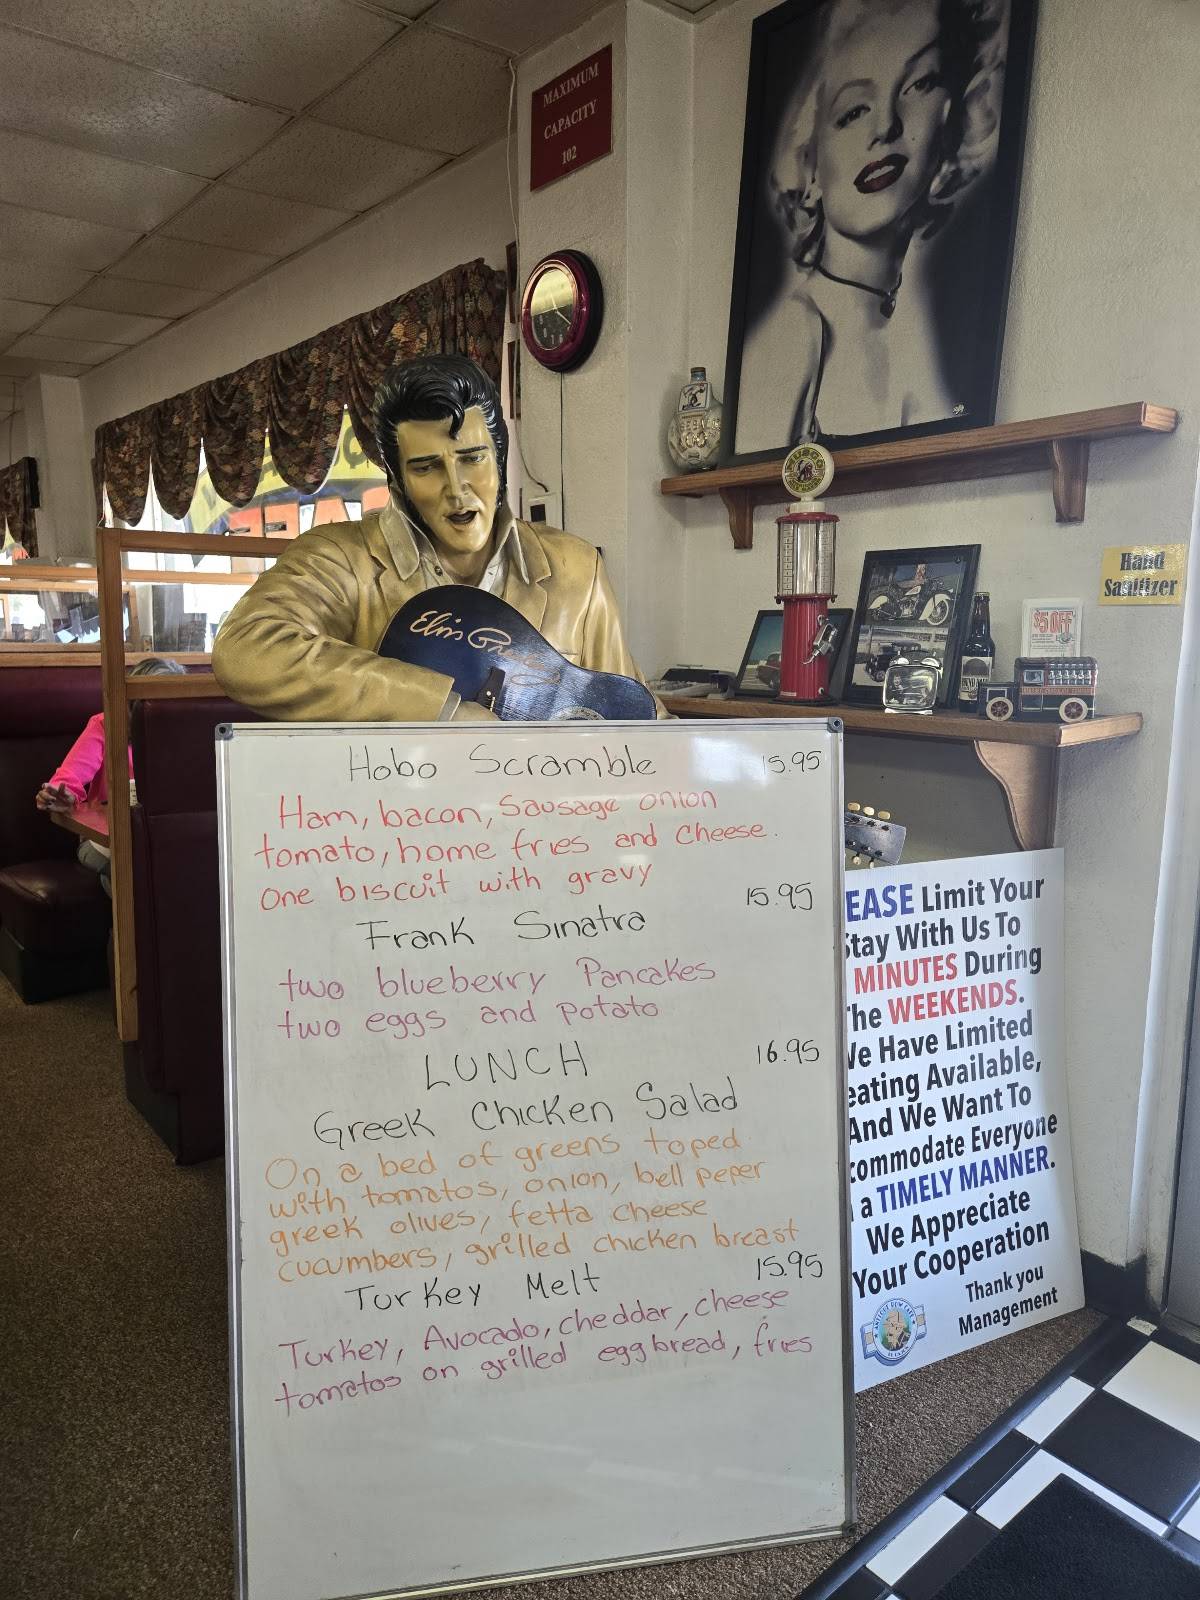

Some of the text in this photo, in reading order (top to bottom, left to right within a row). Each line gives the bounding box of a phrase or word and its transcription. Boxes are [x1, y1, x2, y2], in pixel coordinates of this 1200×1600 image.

[543, 61, 600, 108] MAXIMUM
[543, 98, 599, 141] CAPACITY
[561, 145, 578, 165] 102
[1120, 551, 1166, 571] Hand
[1104, 577, 1178, 597] Sanitizer
[409, 610, 464, 641] Elvis
[1033, 610, 1073, 634] $5 OFF
[349, 744, 822, 781] Hobo Scramble 15.95
[279, 794, 368, 831] Ham,
[379, 800, 493, 830] bacon,
[639, 790, 718, 811] onion
[254, 833, 388, 869] tomato,
[397, 837, 497, 864] home
[511, 828, 590, 861] fries
[615, 823, 658, 848] and
[336, 868, 451, 902] biscuit
[479, 867, 541, 894] with
[568, 864, 653, 895] gravy
[746, 882, 813, 911] 15.95
[846, 877, 1045, 922] EASE Limit Your
[514, 905, 646, 940] Sinatra
[896, 917, 954, 952] With
[961, 915, 990, 943] Us
[995, 911, 1021, 938] To
[279, 968, 345, 1002] two
[377, 965, 546, 998] blueberry
[854, 943, 1042, 995] MINUTES During
[277, 1010, 341, 1039] two
[365, 1010, 447, 1040] eggs
[480, 1000, 536, 1024] and
[847, 978, 1025, 1032] he WEEKENDS.
[757, 1038, 820, 1065] 16.95
[878, 1031, 939, 1064] Have
[945, 1008, 1033, 1051] Limited
[425, 1040, 588, 1090] LUNCH
[848, 1045, 1042, 1107] eating Available,
[636, 1076, 738, 1120] Salad
[899, 1102, 937, 1133] We
[942, 1088, 1004, 1123] Want
[1007, 1082, 1032, 1109] To
[971, 1112, 1058, 1152] Everyone
[265, 1127, 743, 1190] On a bed of greens toped
[269, 1160, 767, 1219] with tomatos, onion, bell peper
[860, 1196, 873, 1219] a
[876, 1166, 954, 1213] TIMELY
[959, 1145, 1056, 1192] MANNER.
[269, 1215, 364, 1258] greek
[390, 1209, 490, 1236] olives,
[508, 1198, 593, 1228] fetta
[465, 1231, 571, 1266] grilled
[593, 1228, 697, 1254] chicken
[713, 1218, 800, 1249] breast
[866, 1190, 1031, 1256] We Appreciate
[757, 1250, 824, 1281] 15.95
[852, 1220, 1050, 1299] Your Cooperation
[527, 1263, 600, 1301] Melt
[965, 1264, 1045, 1303] Thank you
[424, 1317, 551, 1351] Avocado,
[559, 1299, 689, 1336] cheddar,
[695, 1288, 790, 1317] cheese
[958, 1285, 1059, 1337] Management
[275, 1370, 402, 1417] tomatos
[422, 1364, 458, 1382] on
[480, 1340, 567, 1380] grilled
[754, 1319, 813, 1357] fries
